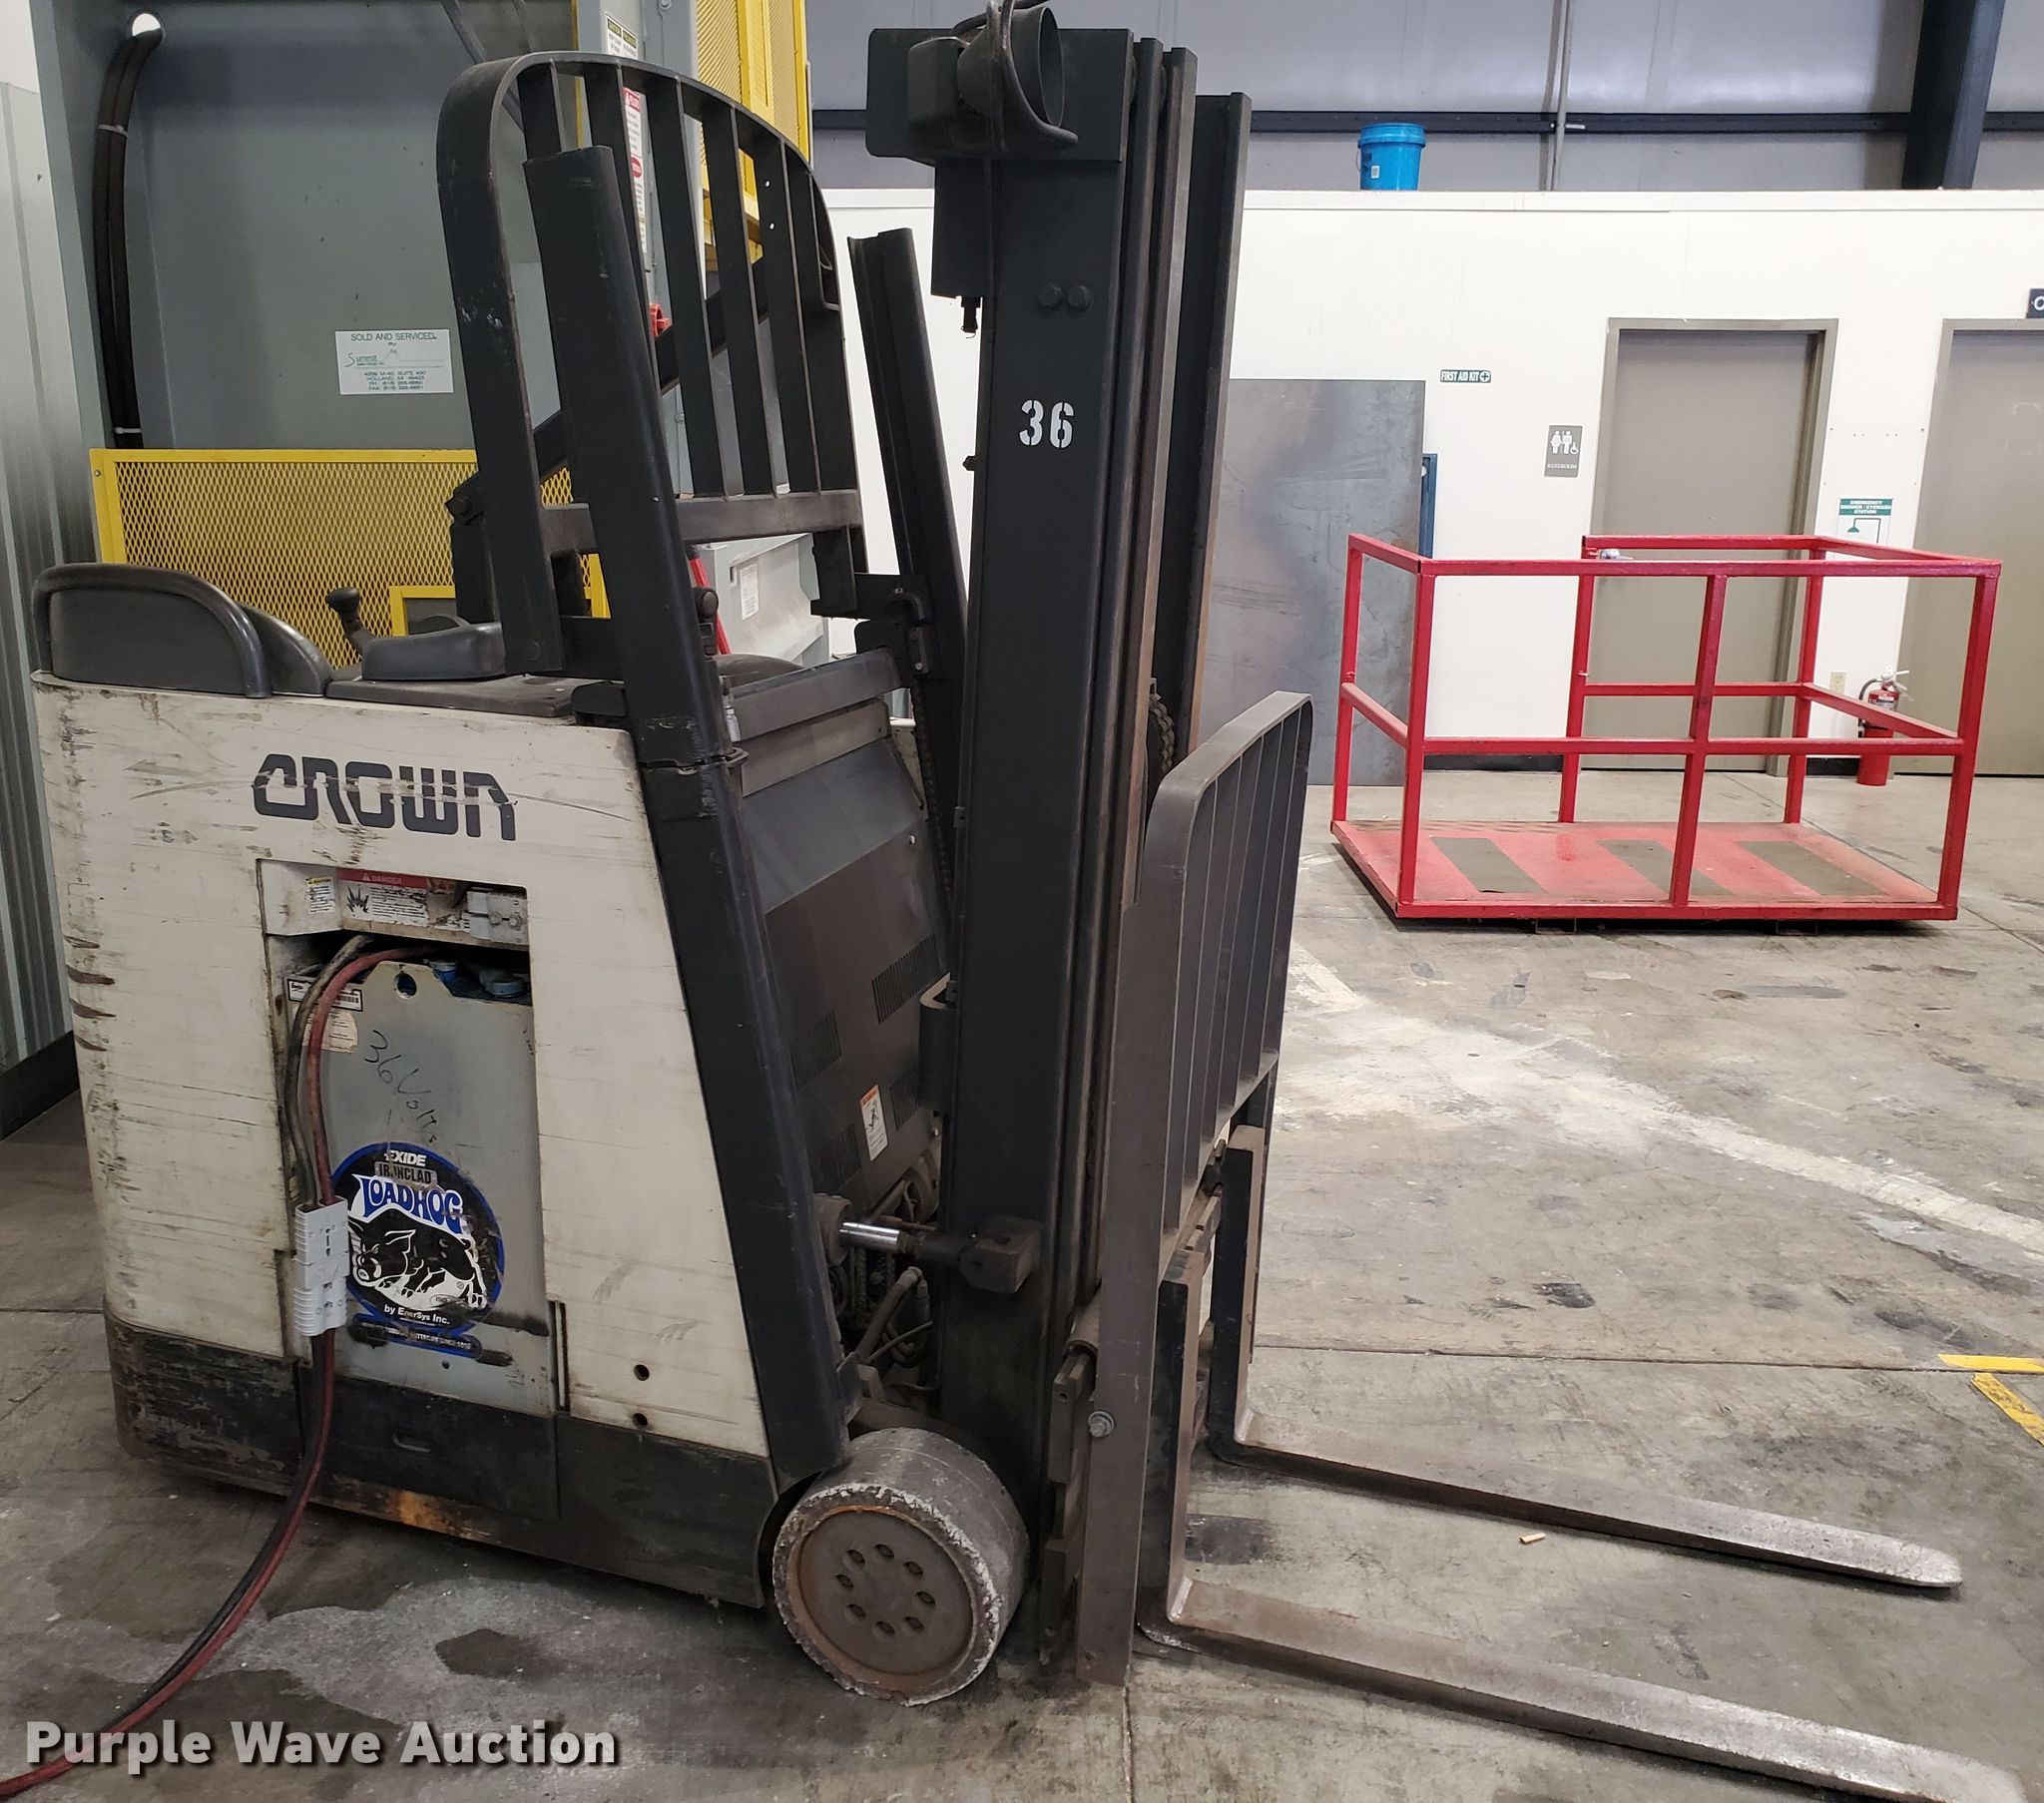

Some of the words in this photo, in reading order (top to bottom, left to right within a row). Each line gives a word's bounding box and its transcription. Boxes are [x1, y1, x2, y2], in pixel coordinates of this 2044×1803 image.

[375, 332, 393, 341] AND
[1441, 371, 1458, 382] FIRST
[1457, 370, 1469, 382] AID
[1469, 371, 1480, 382] KIT
[1019, 399, 1074, 449] 36
[253, 753, 516, 841] CROWN
[371, 874, 402, 886] DANGER
[384, 1149, 427, 1166] EXIDE
[359, 1176, 464, 1235] LOADHOG
[383, 1304, 395, 1315] by
[432, 1313, 451, 1325] Inc.
